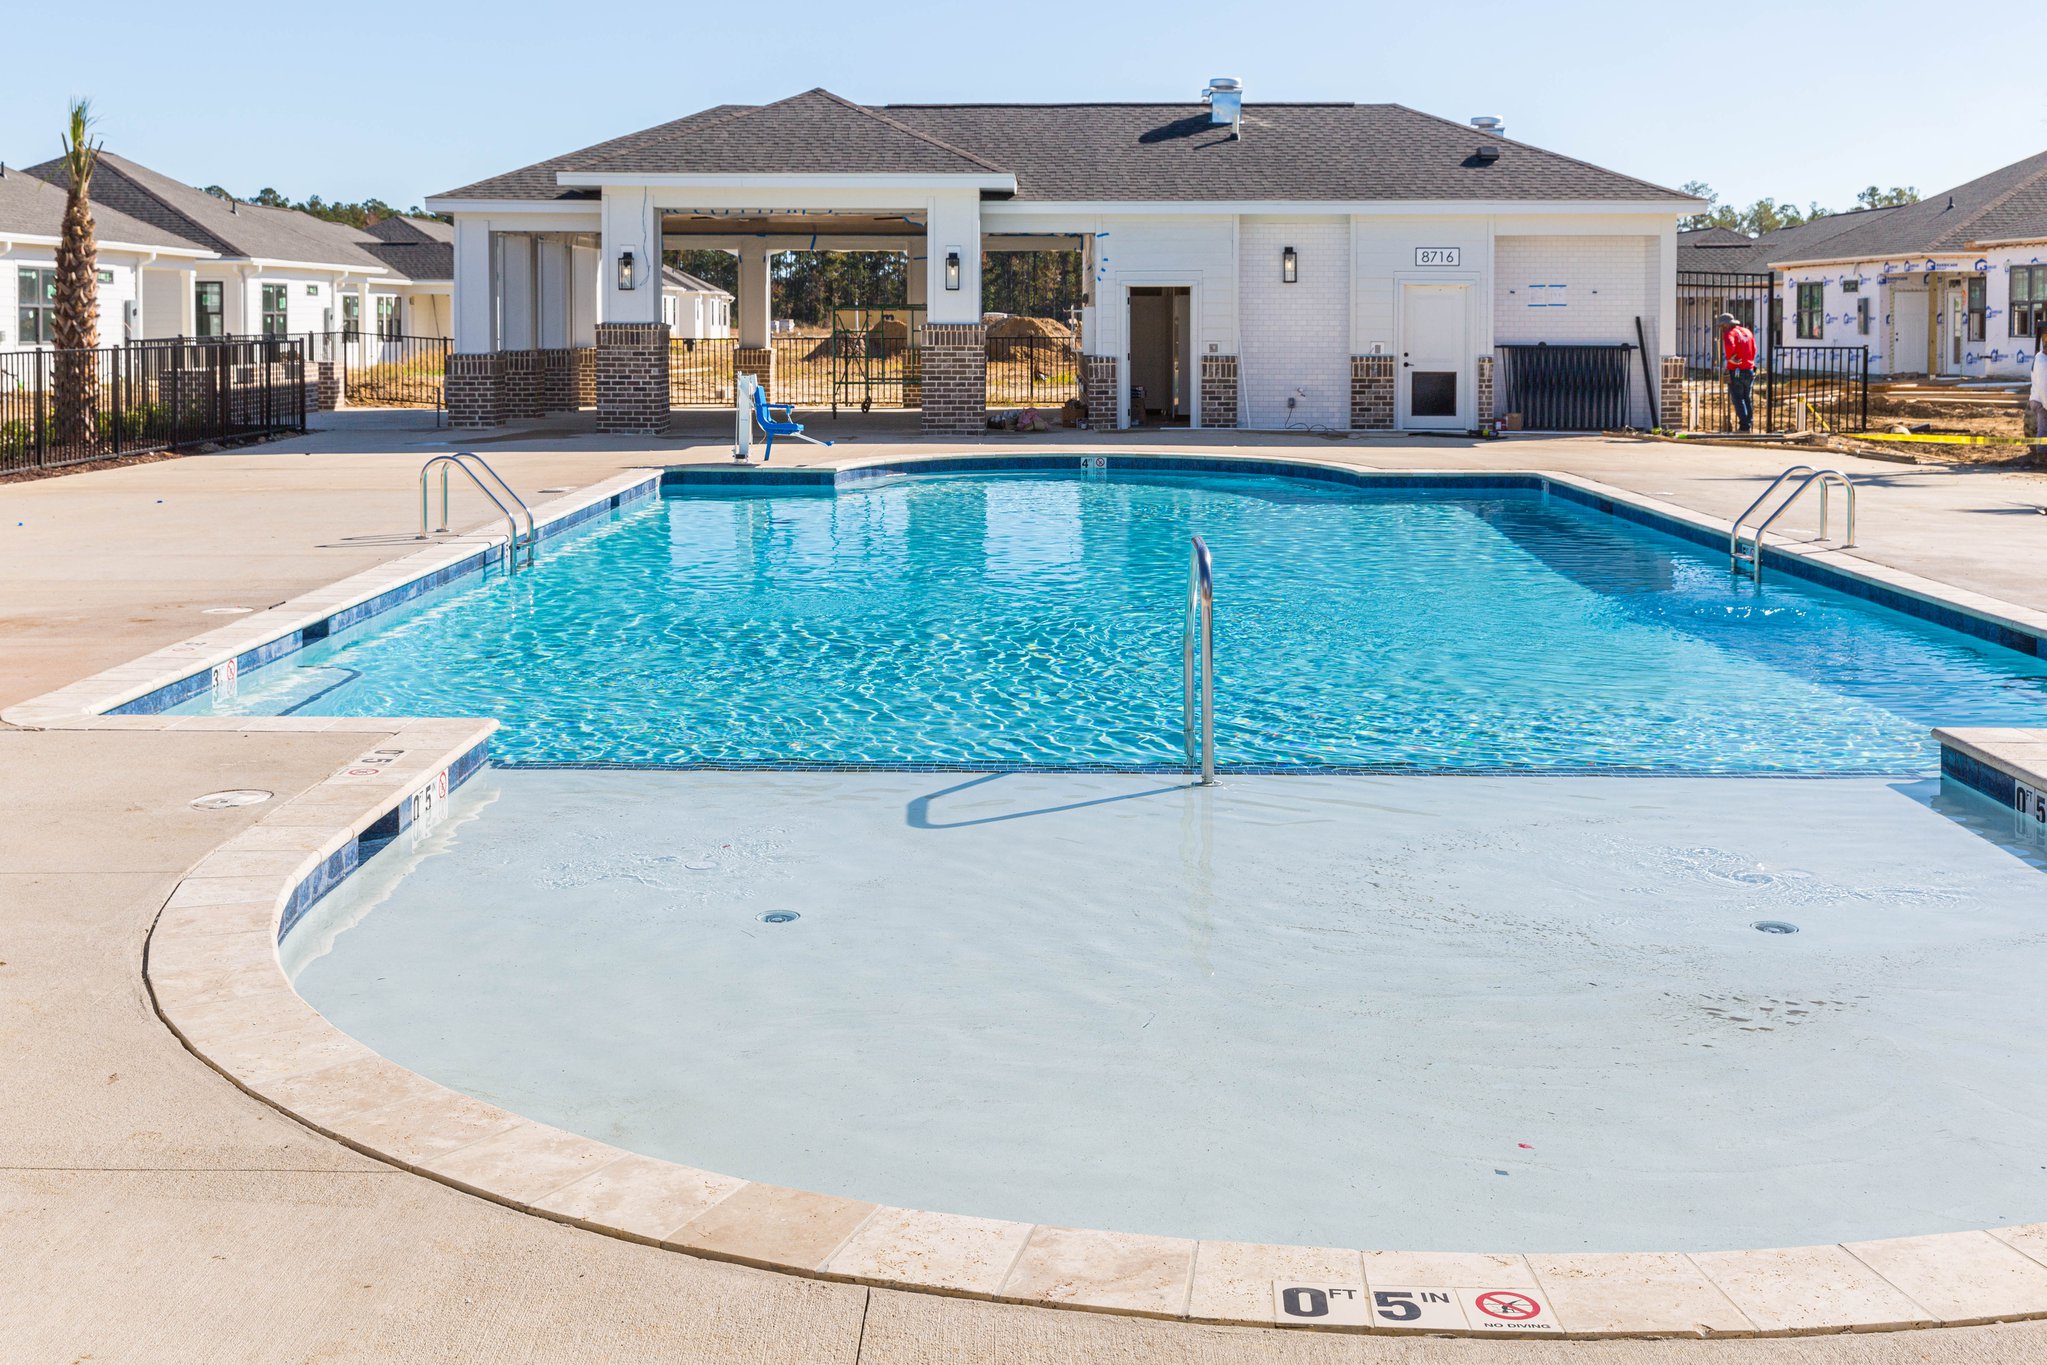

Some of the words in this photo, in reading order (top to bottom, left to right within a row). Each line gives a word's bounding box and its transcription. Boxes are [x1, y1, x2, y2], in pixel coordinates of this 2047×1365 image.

[1421, 251, 1454, 263] 8716
[1082, 459, 1088, 468] 4
[213, 669, 218, 687] 3
[413, 794, 420, 821] 0
[425, 785, 431, 811] 5
[2017, 787, 2025, 813] 0
[2036, 796, 2045, 823] 5
[1282, 1287, 1329, 1317] 0
[1329, 1289, 1357, 1300] FT
[1373, 1291, 1421, 1321] 5
[1421, 1292, 1450, 1303] IN
